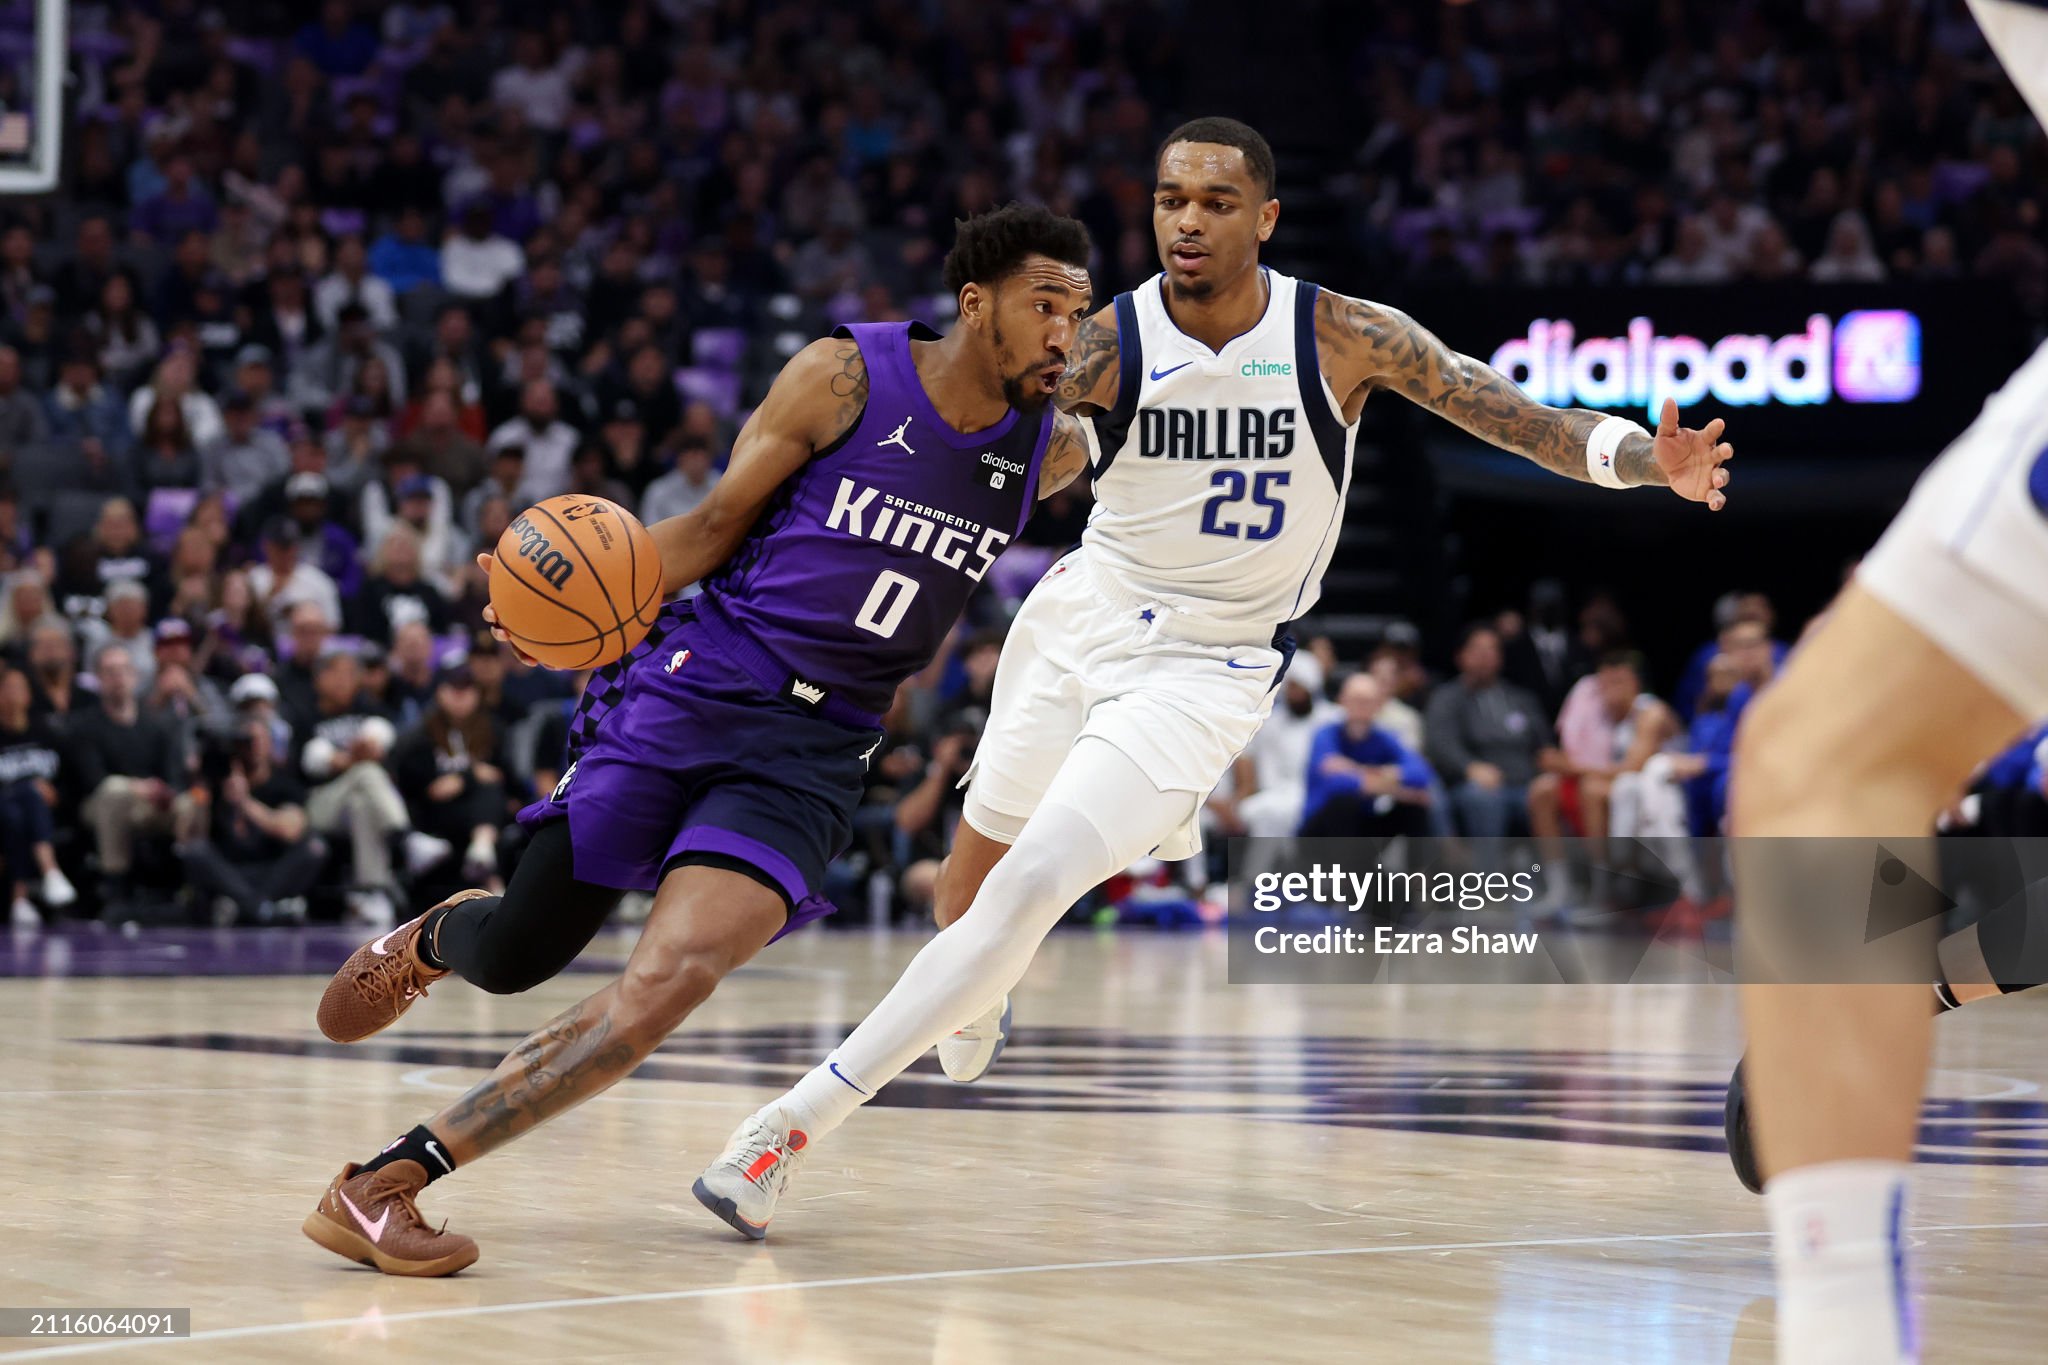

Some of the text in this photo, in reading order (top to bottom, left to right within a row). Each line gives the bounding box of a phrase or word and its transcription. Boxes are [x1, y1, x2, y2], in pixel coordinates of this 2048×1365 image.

[1241, 359, 1291, 377] chime
[1490, 314, 1832, 426] dialpad
[1138, 406, 1297, 461] DALLAS
[981, 451, 1026, 475] dialpad
[883, 494, 981, 533] SACRAMENTO
[1199, 468, 1292, 541] 25
[854, 567, 921, 639] 0
